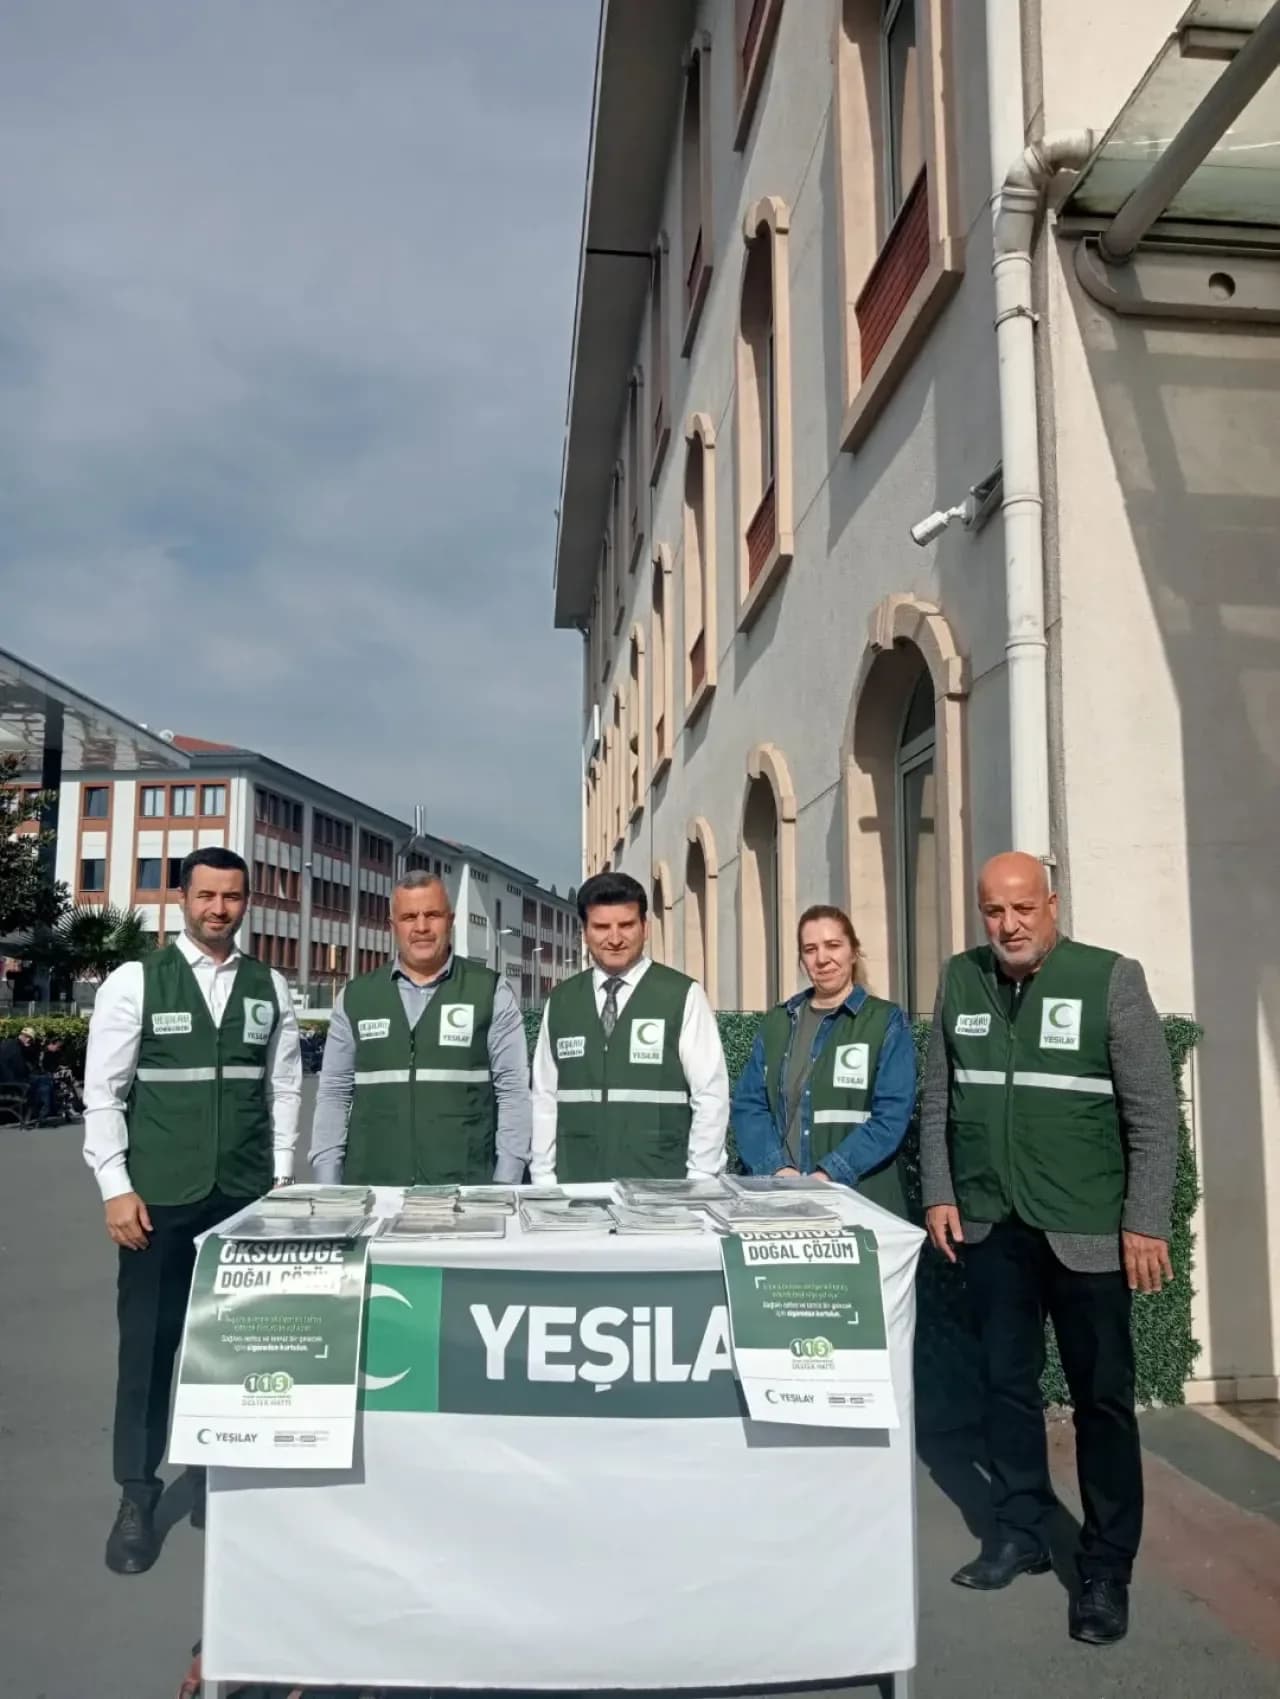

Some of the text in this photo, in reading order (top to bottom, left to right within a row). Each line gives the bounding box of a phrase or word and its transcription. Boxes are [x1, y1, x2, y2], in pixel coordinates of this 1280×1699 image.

[748, 1239, 855, 1263] DOĞAL ÇÖZÜM
[469, 1303, 734, 1393] YEŞİLA
[793, 1340, 827, 1357] 115
[248, 1376, 286, 1392] 115
